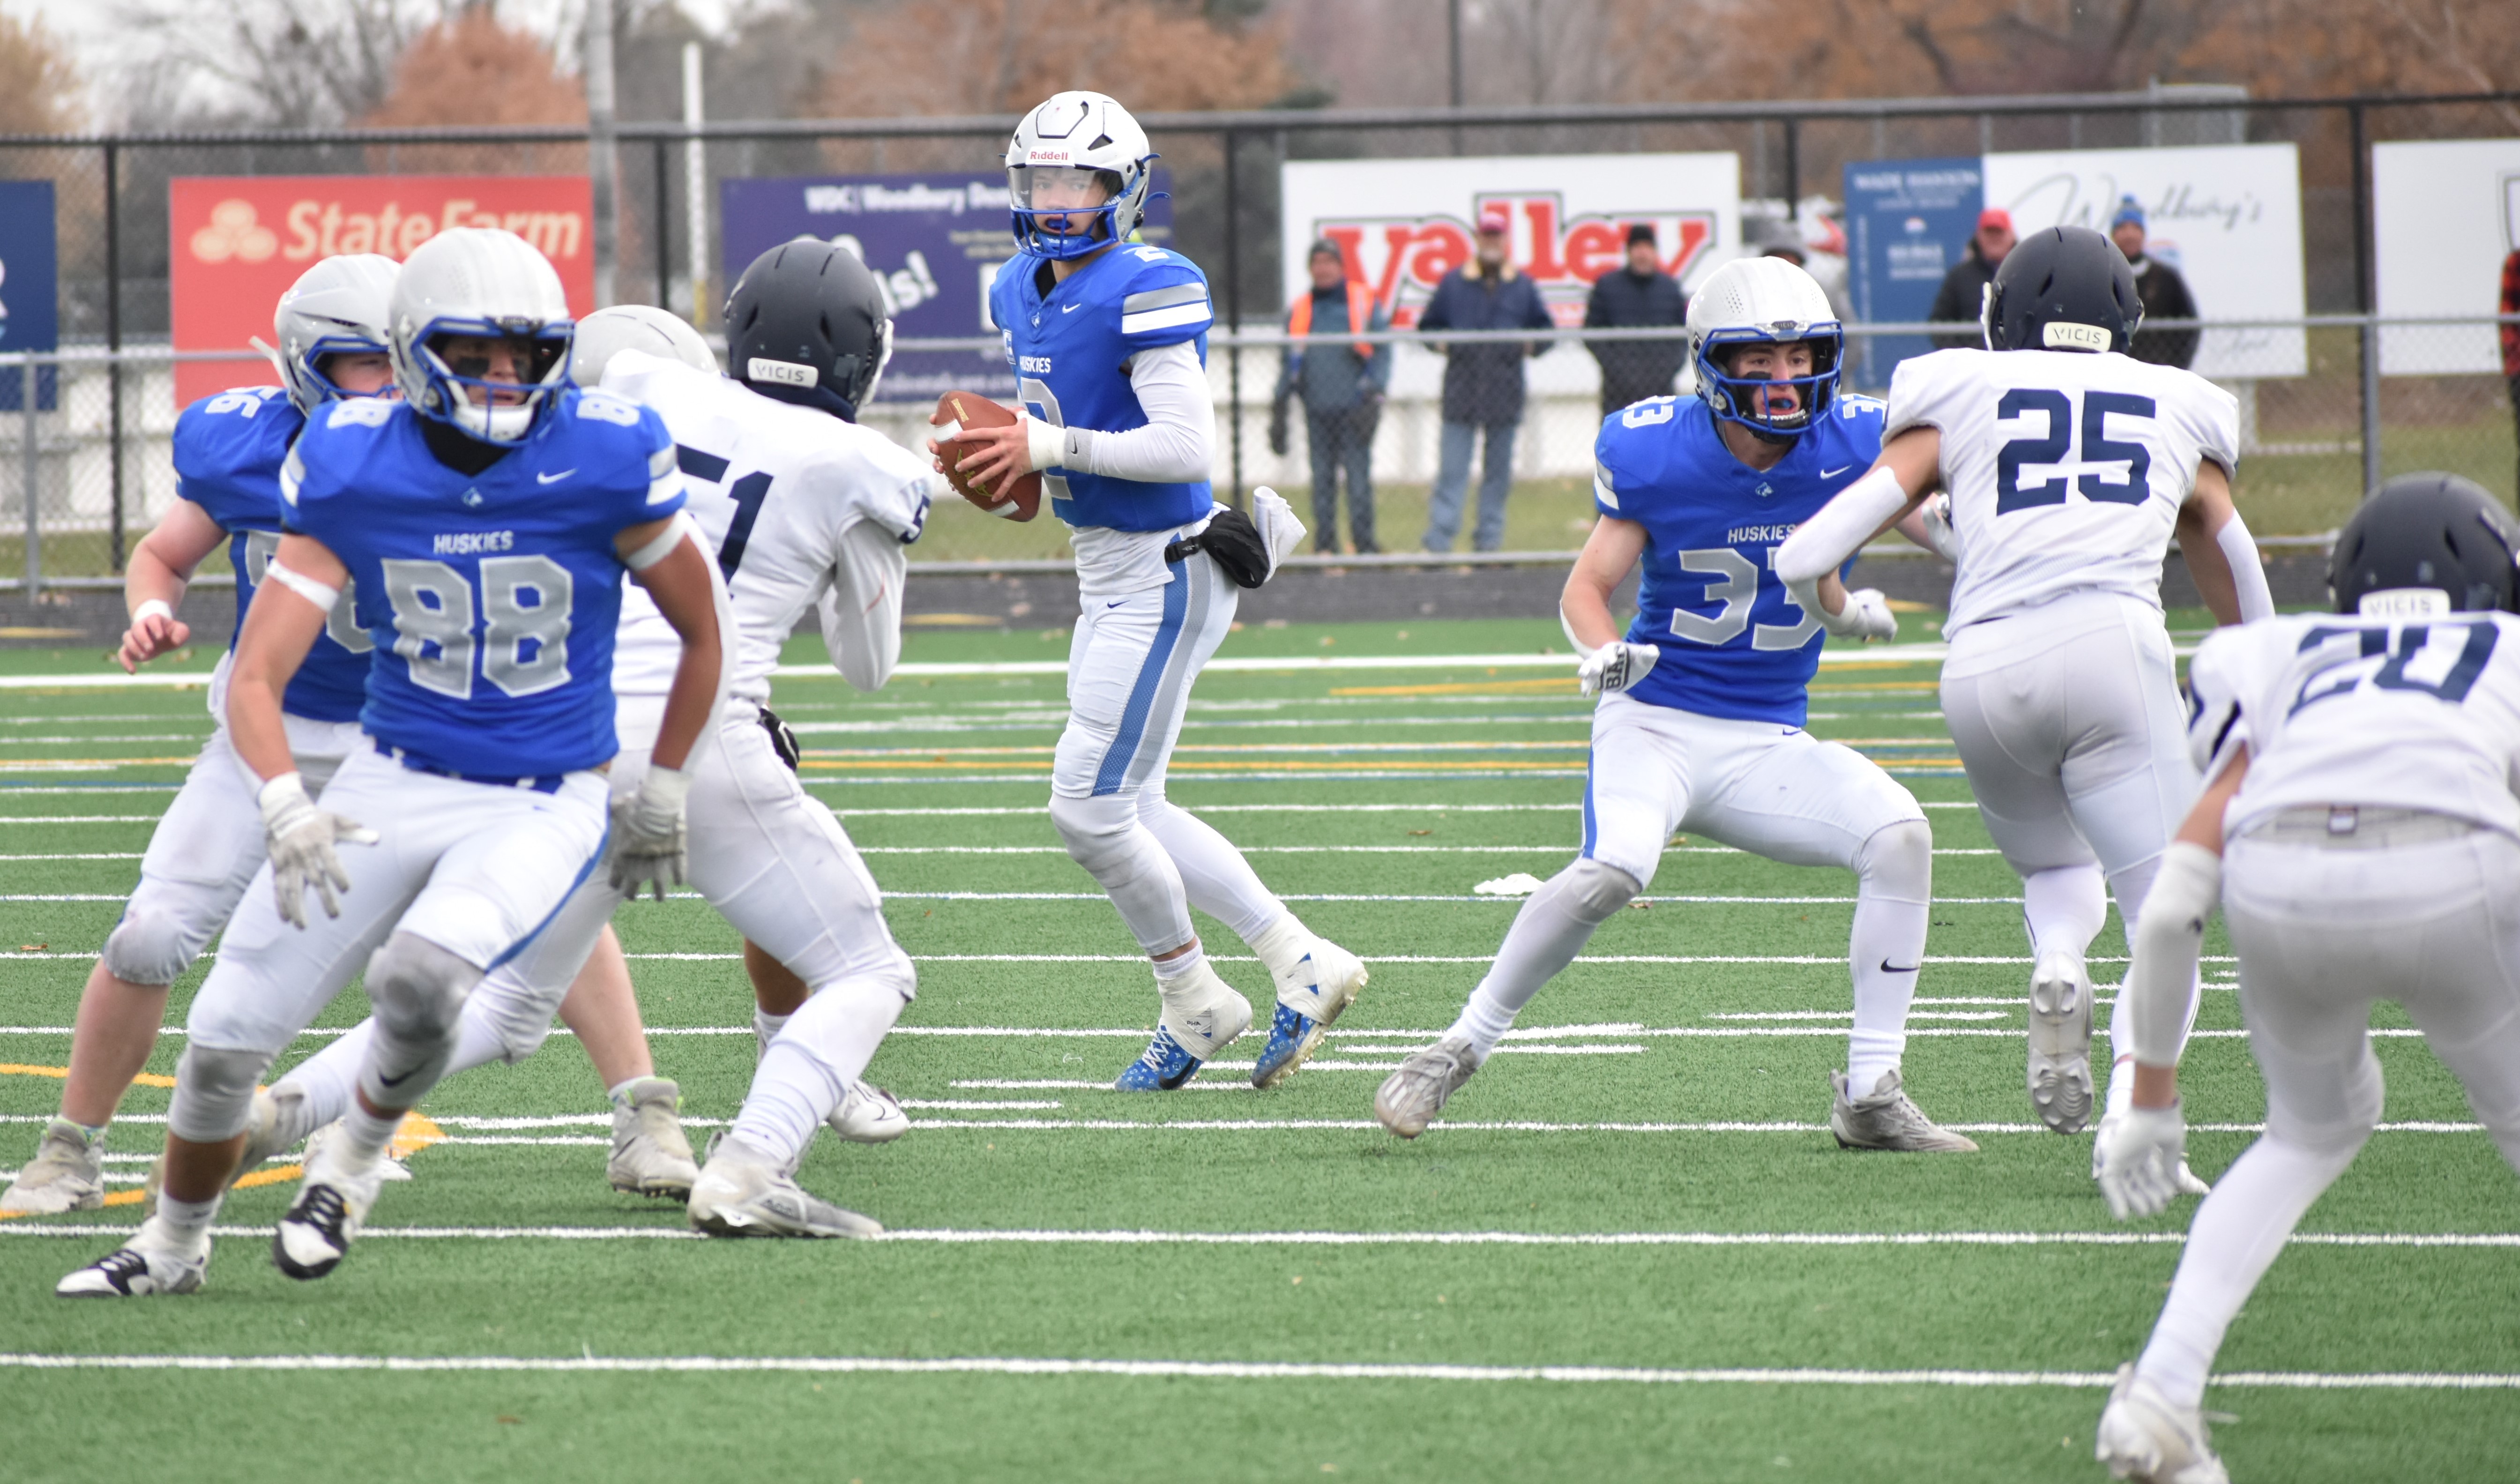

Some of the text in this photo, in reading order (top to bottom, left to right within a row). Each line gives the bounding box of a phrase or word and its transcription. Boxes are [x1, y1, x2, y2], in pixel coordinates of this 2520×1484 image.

[1029, 151, 1068, 161] Riddell
[283, 199, 433, 262] State
[2053, 327, 2102, 344] VICIS
[755, 362, 805, 383] VICIS
[1020, 355, 1051, 373] HUSKIES
[1997, 388, 2156, 516] 25
[434, 530, 514, 554] HUSKIES
[1727, 524, 1797, 544] HUSKIES
[2367, 595, 2432, 615] VICIS
[380, 554, 573, 700] 88
[2284, 621, 2500, 726] 20
